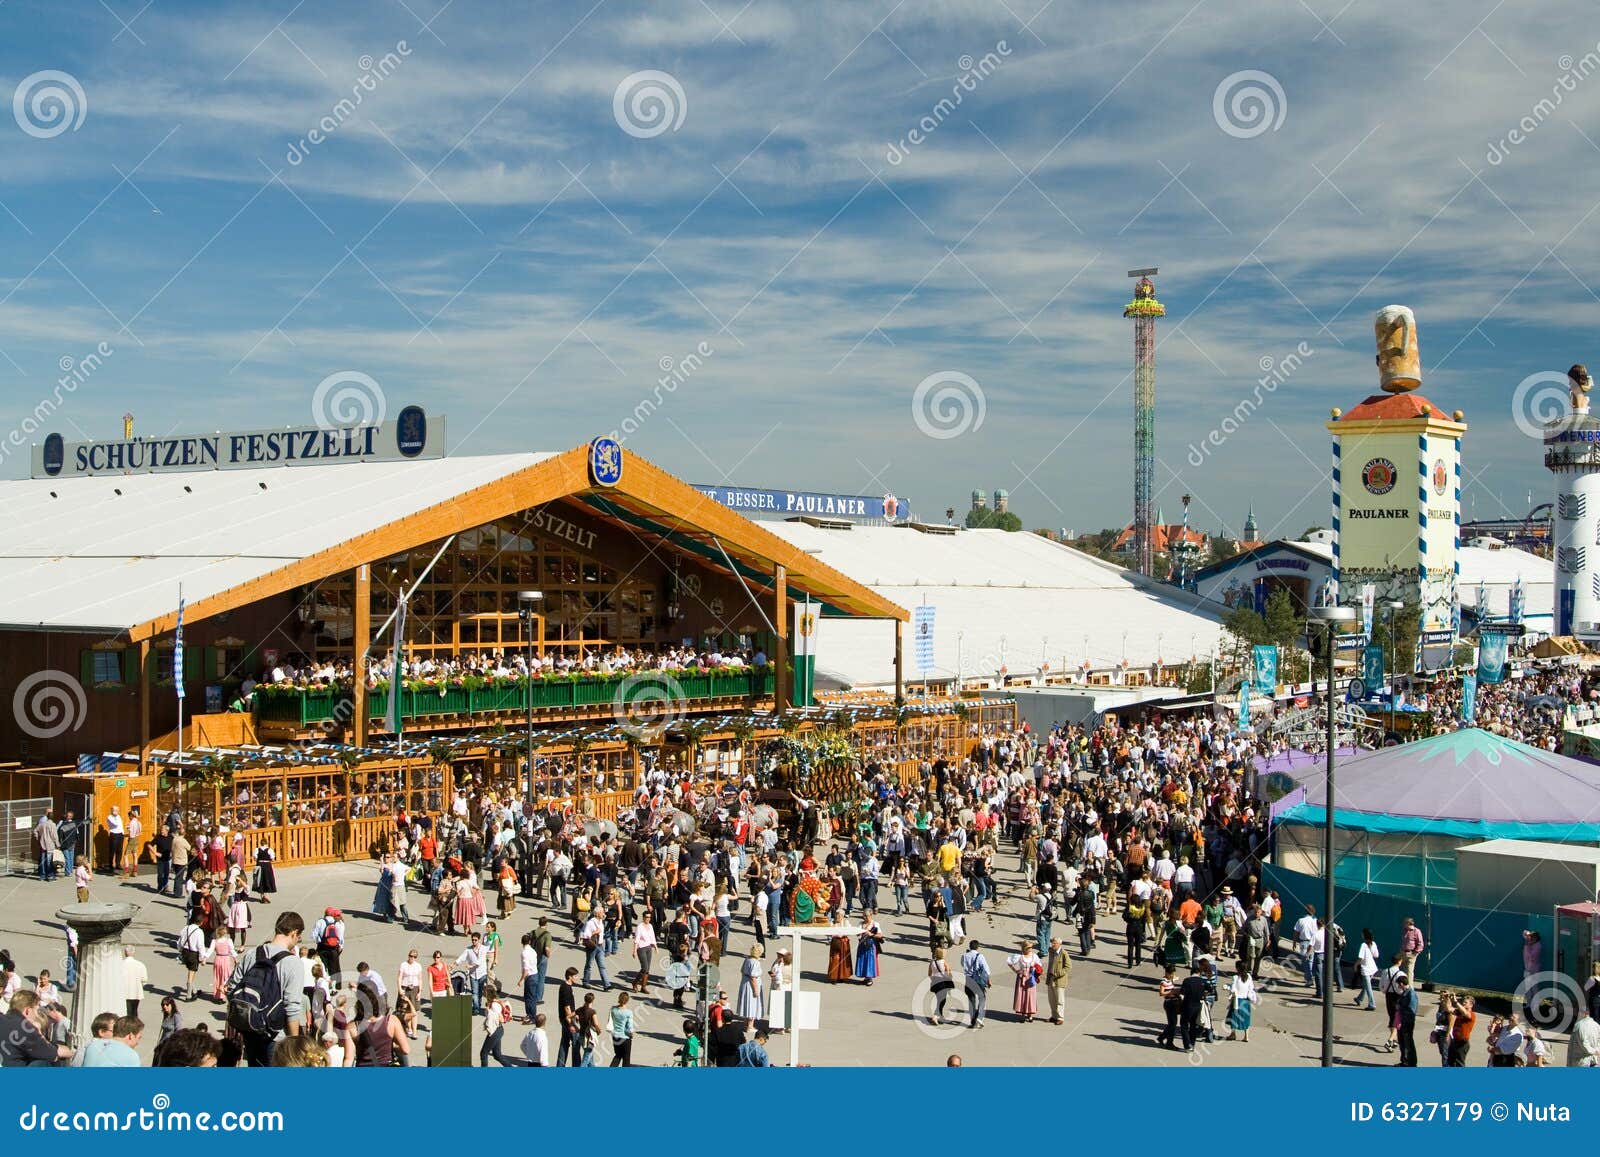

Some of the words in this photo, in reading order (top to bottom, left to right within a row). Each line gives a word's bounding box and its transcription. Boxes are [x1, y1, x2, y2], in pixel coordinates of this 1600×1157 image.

[76, 437, 219, 471] SCHÜTZEN
[229, 426, 380, 463] FESTZELT
[727, 491, 780, 511] BESSER,
[786, 494, 866, 515] PAULANER
[1349, 508, 1410, 519] PAULANER
[513, 508, 597, 549] ESTZELT
